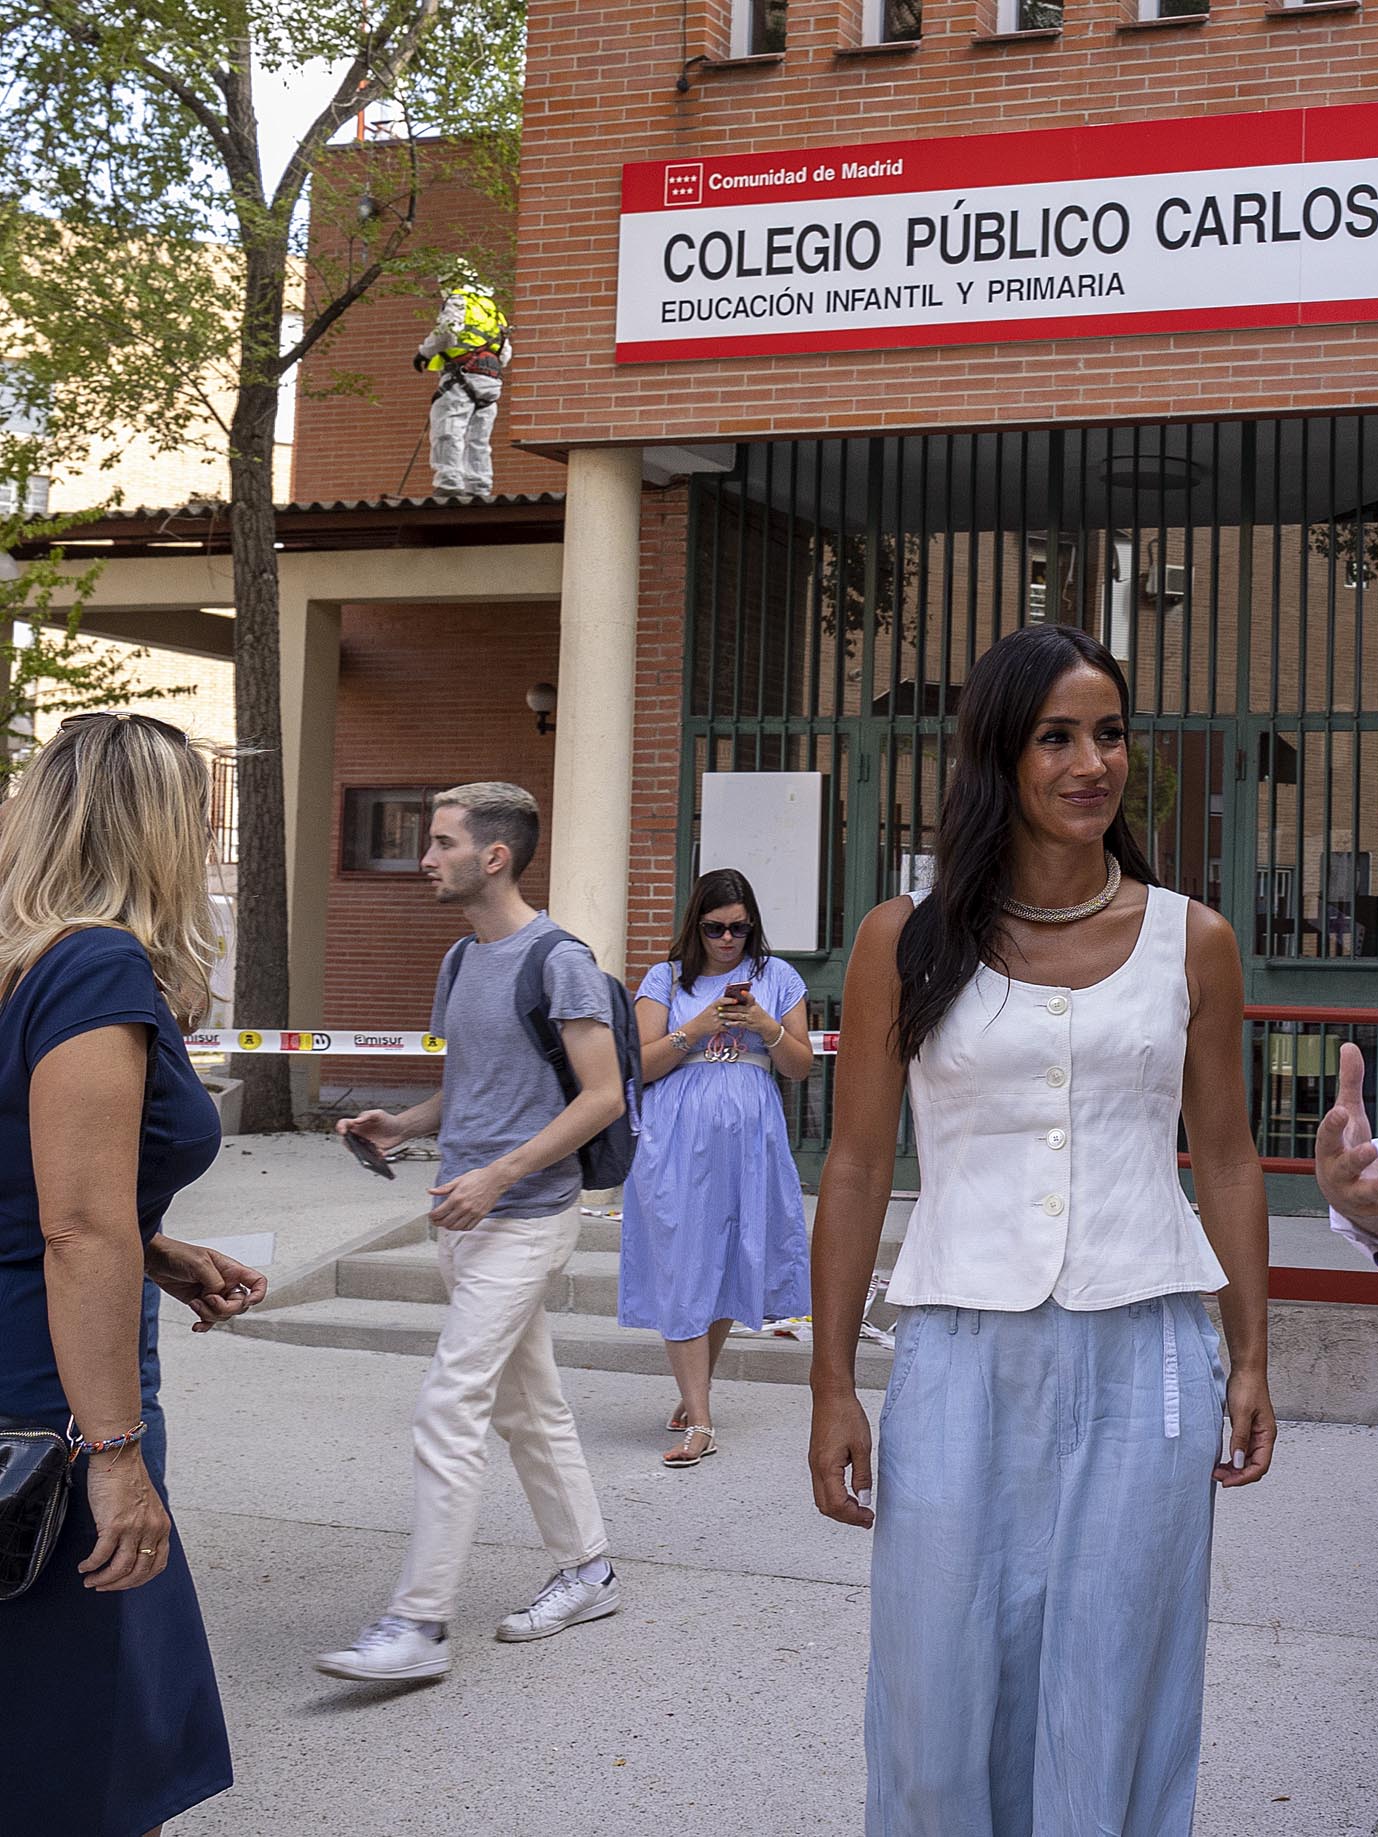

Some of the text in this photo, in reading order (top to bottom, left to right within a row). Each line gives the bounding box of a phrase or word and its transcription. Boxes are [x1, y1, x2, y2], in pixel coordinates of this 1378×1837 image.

[708, 158, 904, 190] Comunidad de Madrid
[664, 220, 881, 283] COLEGIO
[906, 199, 1130, 266] PÚBLICO
[661, 272, 1125, 323] EDUCACIÓN INFANTIL Y PRIMARIA
